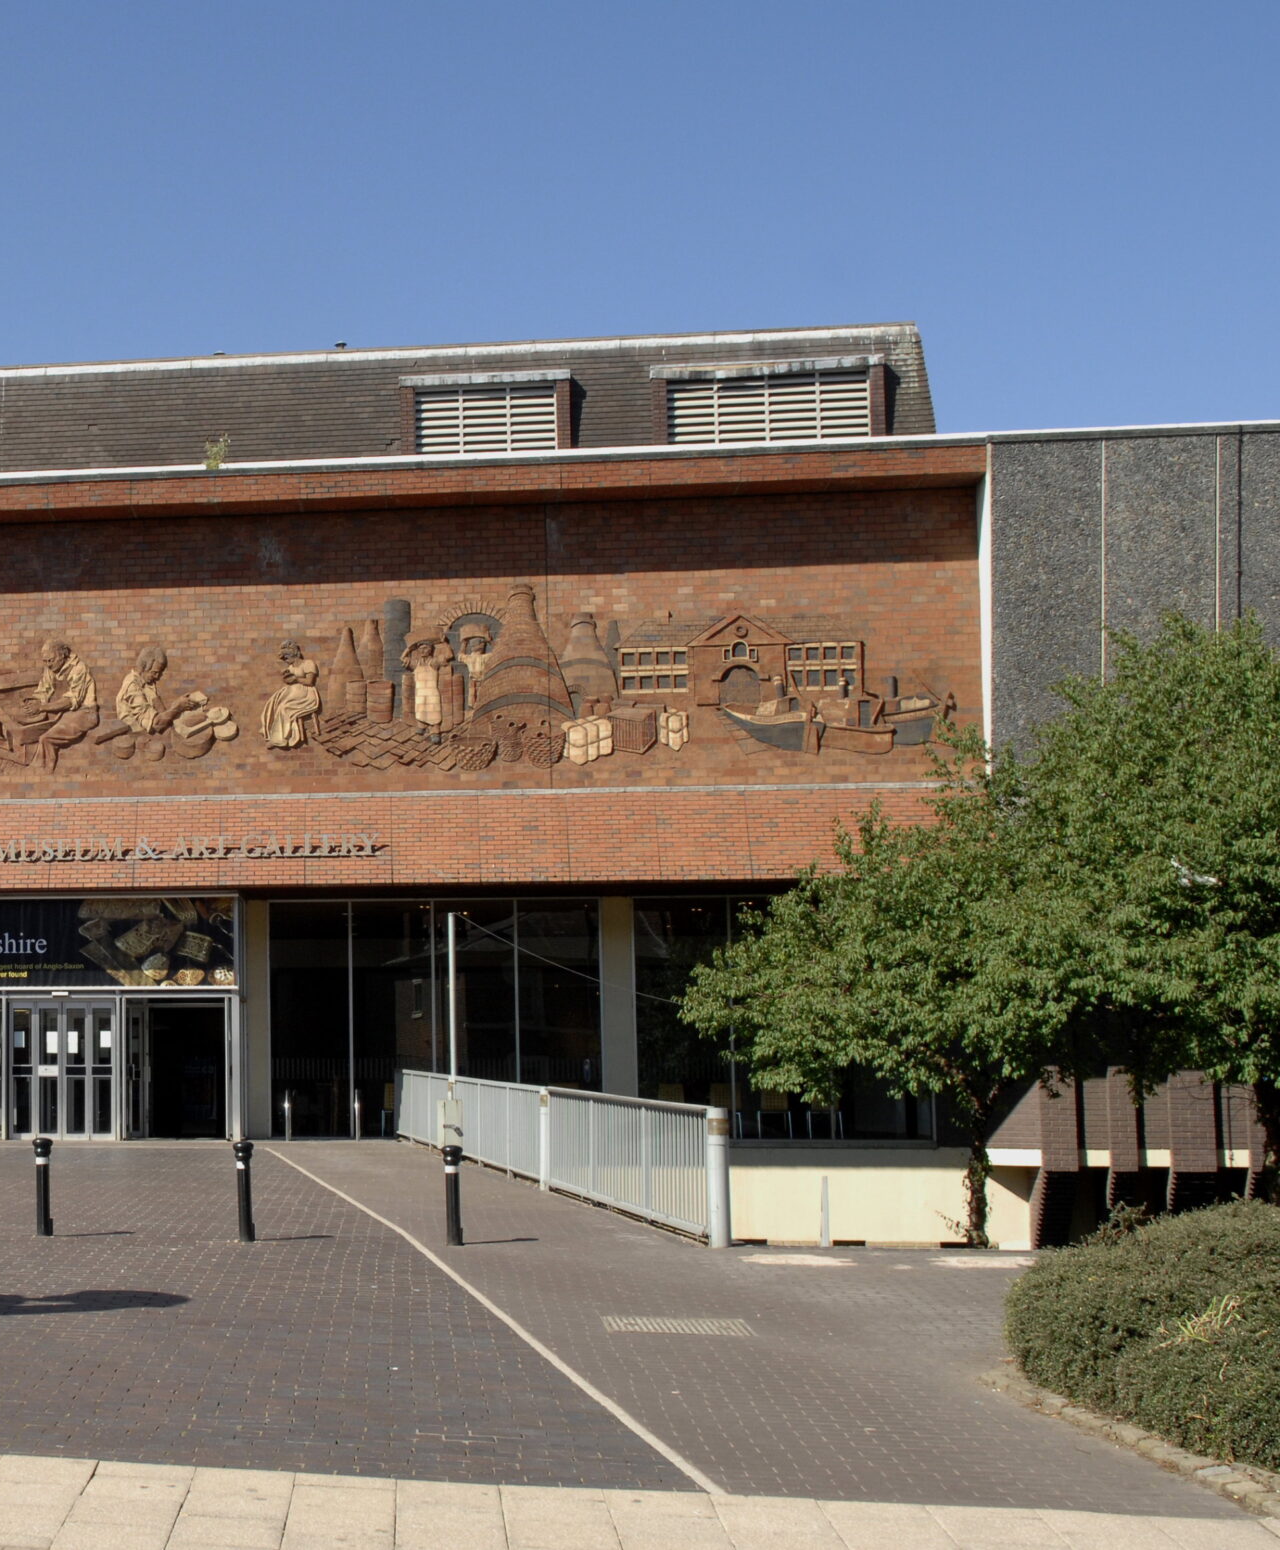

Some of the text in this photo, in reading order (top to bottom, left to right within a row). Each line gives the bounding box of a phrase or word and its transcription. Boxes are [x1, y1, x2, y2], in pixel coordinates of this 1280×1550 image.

[135, 836, 161, 860] &
[172, 835, 232, 859] ART
[241, 833, 382, 858] GALLERY
[42, 962, 85, 971] Anglo-Saxon
[8, 971, 28, 979] found
